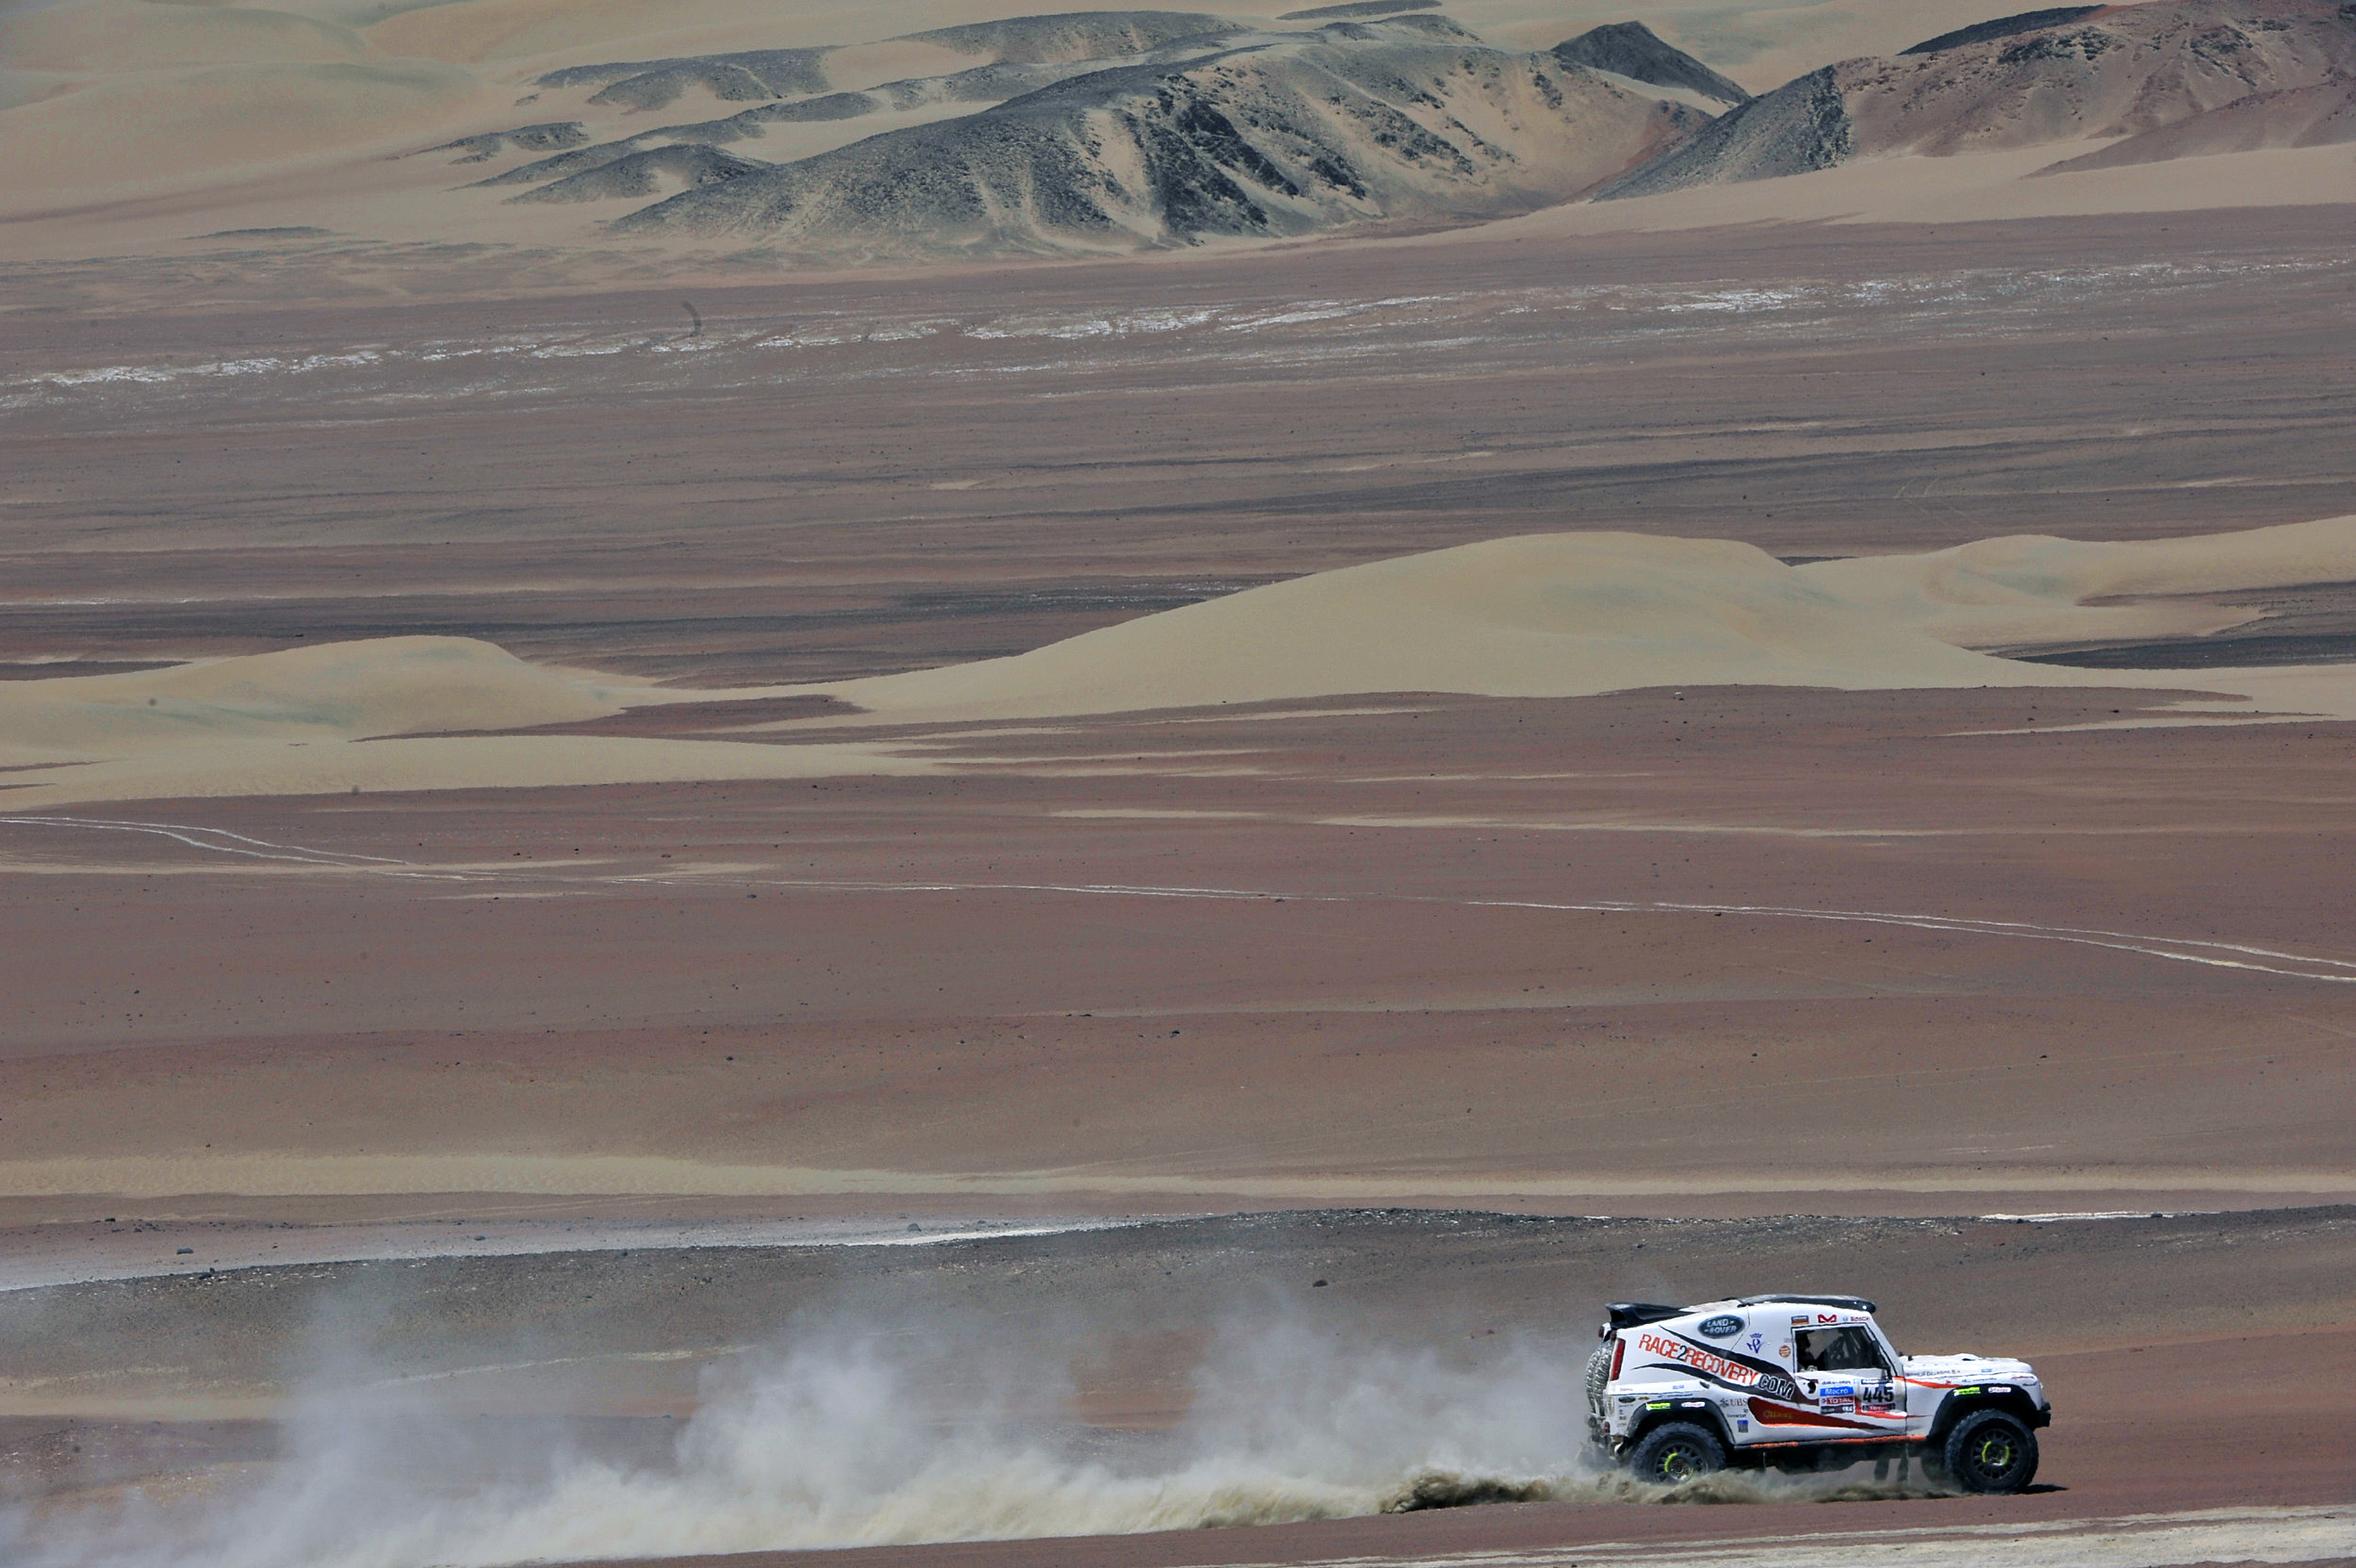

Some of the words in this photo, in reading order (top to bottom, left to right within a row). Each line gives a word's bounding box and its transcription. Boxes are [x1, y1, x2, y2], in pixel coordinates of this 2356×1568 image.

[1706, 1319, 1729, 1327] LAND
[1863, 1387, 1894, 1403] 445
[1730, 1398, 1748, 1407] UBS
